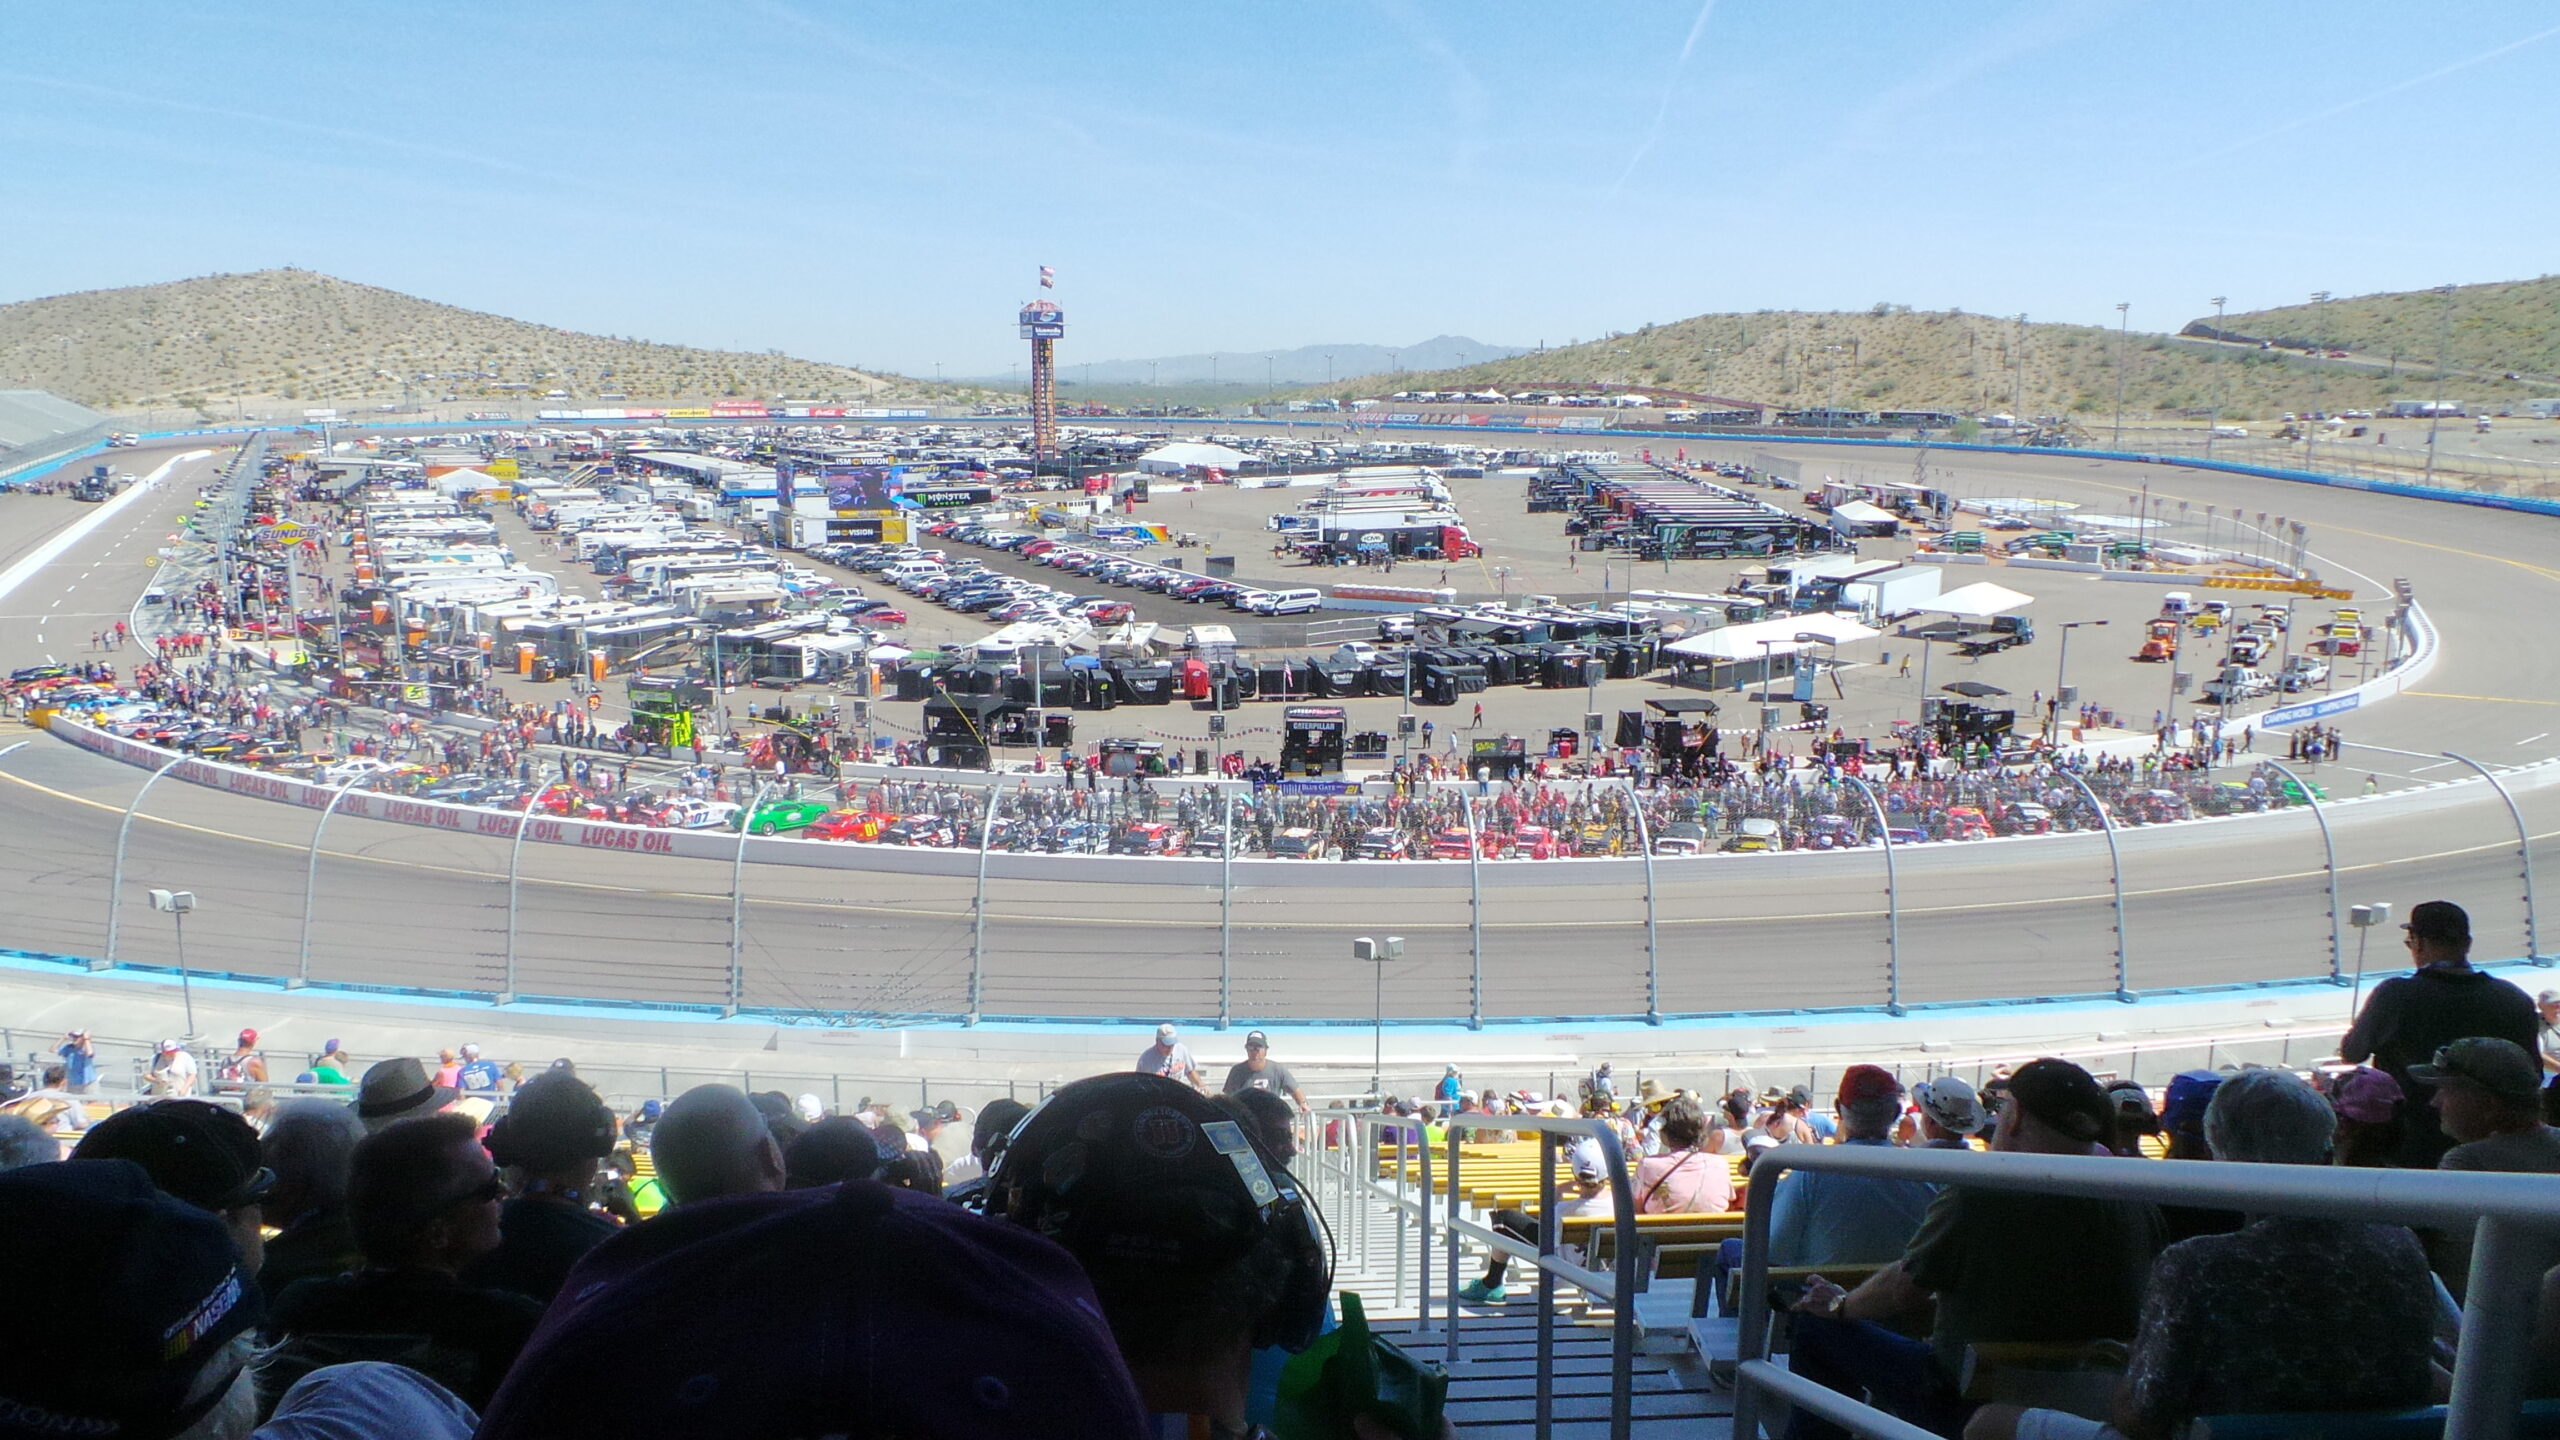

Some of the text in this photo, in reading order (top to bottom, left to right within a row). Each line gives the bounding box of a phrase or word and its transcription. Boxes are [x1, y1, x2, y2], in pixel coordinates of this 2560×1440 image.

[835, 457, 889, 466] ISM VISION
[927, 491, 971, 502] MONSTER
[262, 528, 317, 540] SUNOCO
[827, 528, 841, 537] ISM
[849, 528, 874, 537] VISION
[1293, 722, 1336, 731] CATERPILLAR
[202, 765, 218, 785] OIL
[229, 772, 289, 800] LUCAS OIL
[1301, 782, 1318, 791] BLUE
[1318, 782, 1336, 791] GATE
[1344, 784, 1360, 795] 21
[346, 794, 369, 814] OIL
[384, 801, 461, 828] LUCAS OIL
[534, 821, 563, 842] OIL
[863, 822, 878, 838] 01
[580, 826, 673, 853] LUCAS OIL
